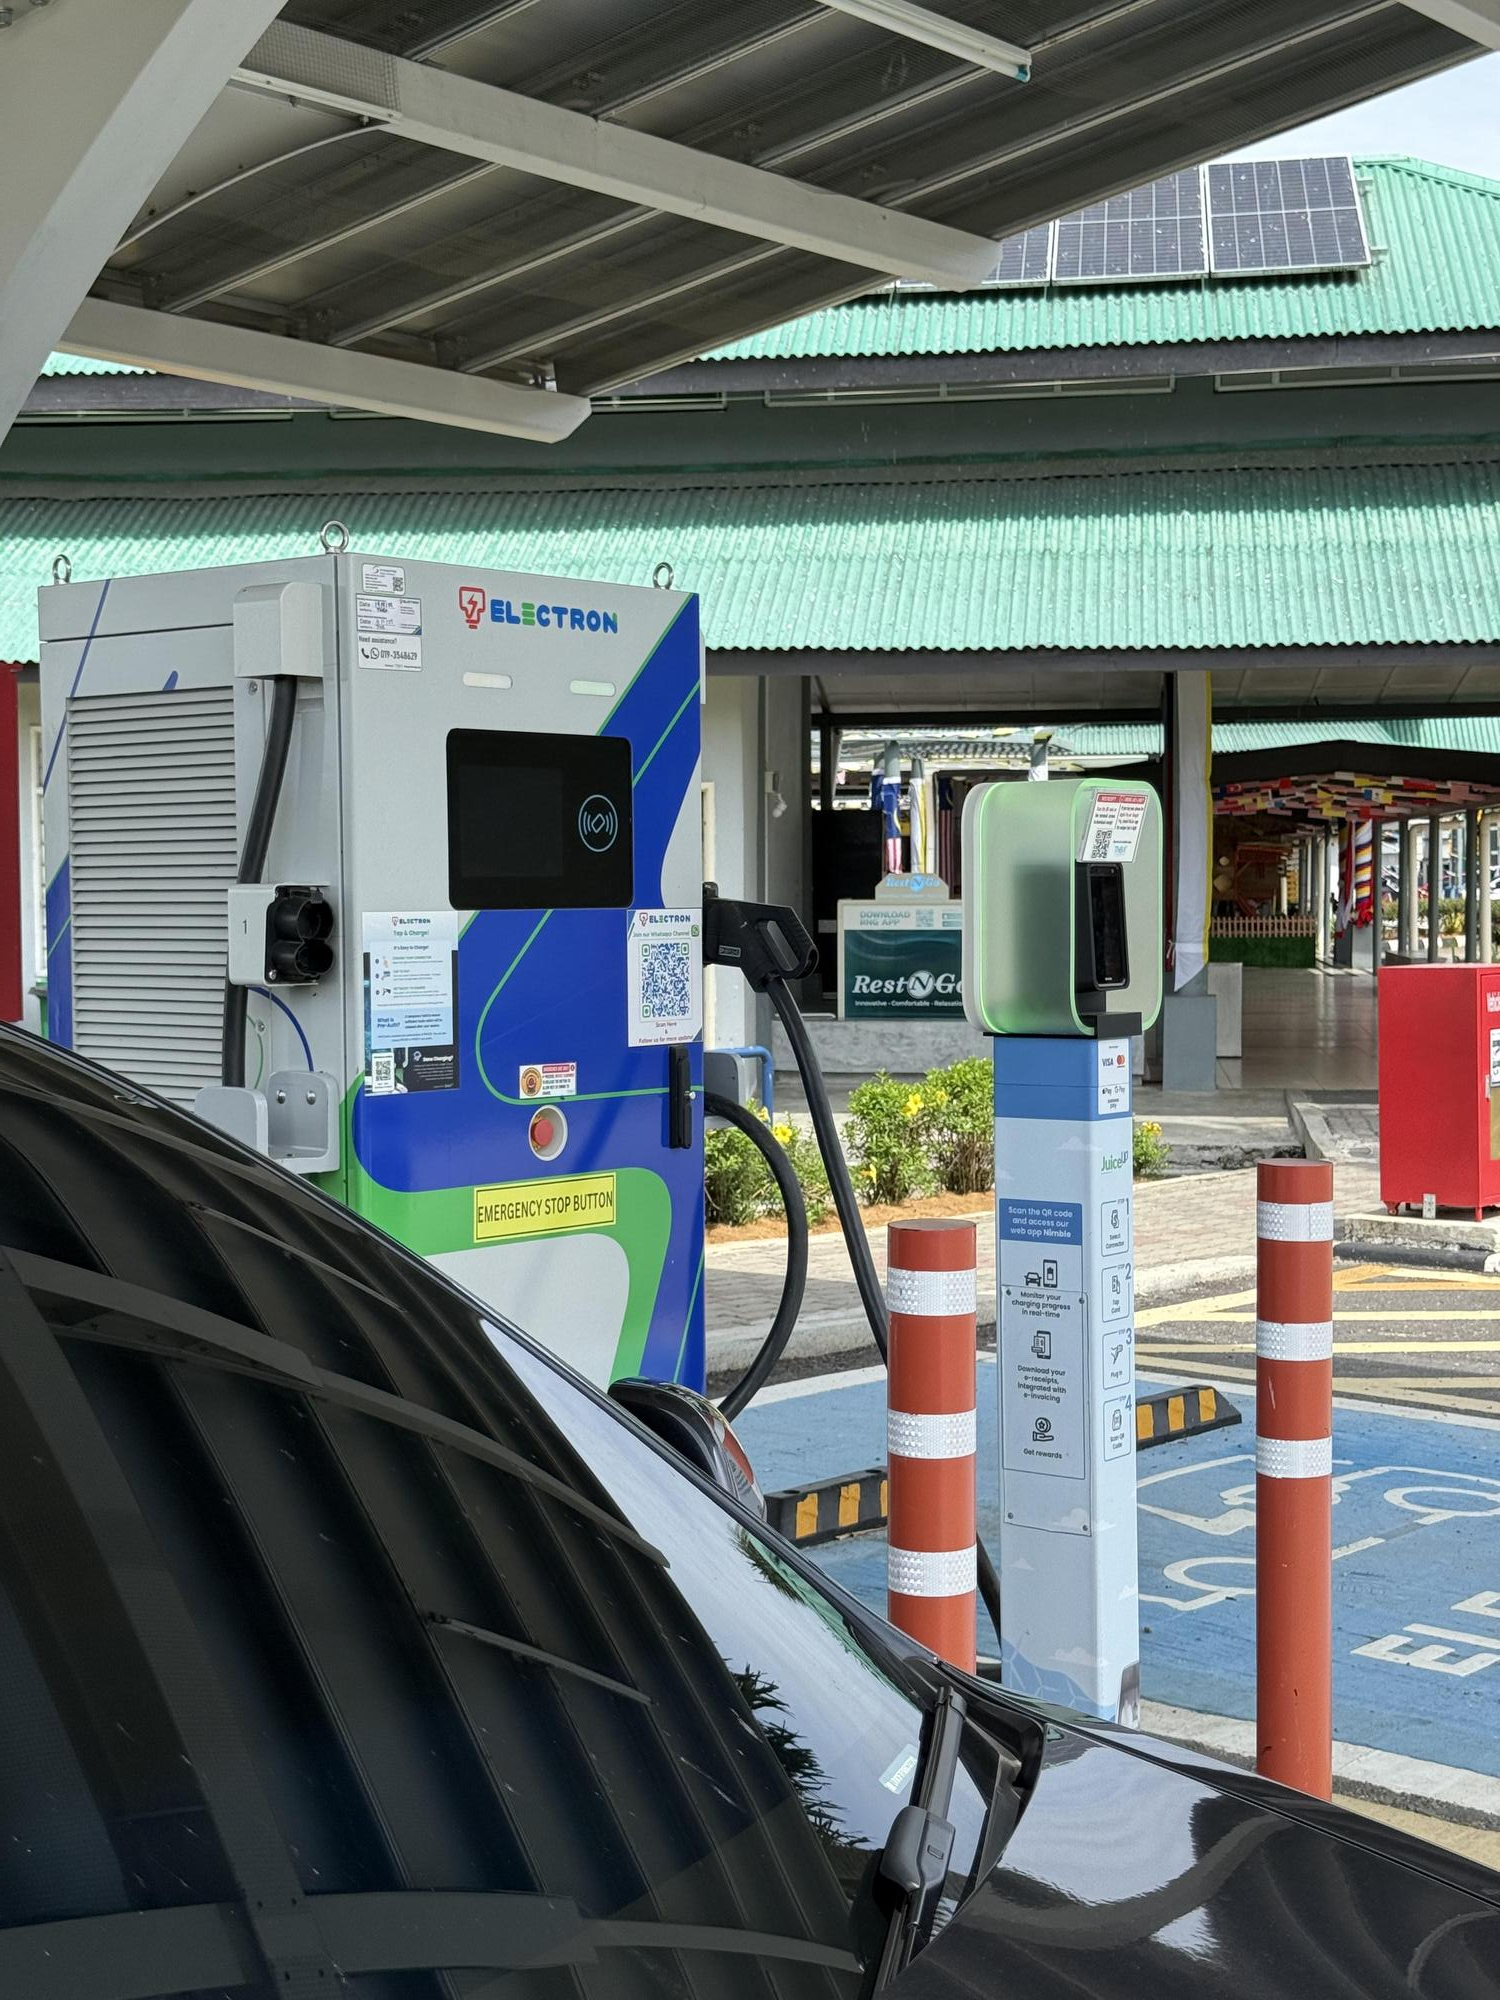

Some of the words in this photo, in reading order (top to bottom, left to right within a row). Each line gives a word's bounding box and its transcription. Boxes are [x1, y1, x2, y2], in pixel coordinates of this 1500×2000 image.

[491, 599, 618, 634] ELECTRON
[649, 914, 691, 924] ELECTRON
[860, 911, 910, 919] DOWNLOAD
[242, 919, 248, 935] 1
[1102, 1058, 1114, 1067] VISA
[478, 1199, 543, 1223] EMERGENCY
[545, 1196, 571, 1215] STOP
[573, 1190, 613, 1211] BUTTON
[1008, 1206, 1027, 1215] Scan
[1028, 1207, 1040, 1216] the
[1041, 1208, 1052, 1217] QR
[1053, 1209, 1073, 1218] code
[1012, 1216, 1027, 1224] and
[1028, 1219, 1055, 1227] access
[1027, 1229, 1042, 1237] app
[1043, 1228, 1071, 1238] Nimble
[1125, 1263, 1131, 1280] 2
[1020, 1291, 1045, 1299] Monitor
[1012, 1299, 1040, 1308] charging
[1042, 1302, 1071, 1311] progress
[1029, 1309, 1060, 1318] real-time
[1126, 1328, 1132, 1345] 3
[1017, 1365, 1050, 1375] Download
[1024, 1375, 1059, 1384] e-receipts,
[1052, 1386, 1067, 1394] with
[1023, 1392, 1061, 1403] e-invoicing
[1125, 1394, 1132, 1411] 4
[1023, 1448, 1035, 1456] Get
[1035, 1449, 1063, 1459] rewards
